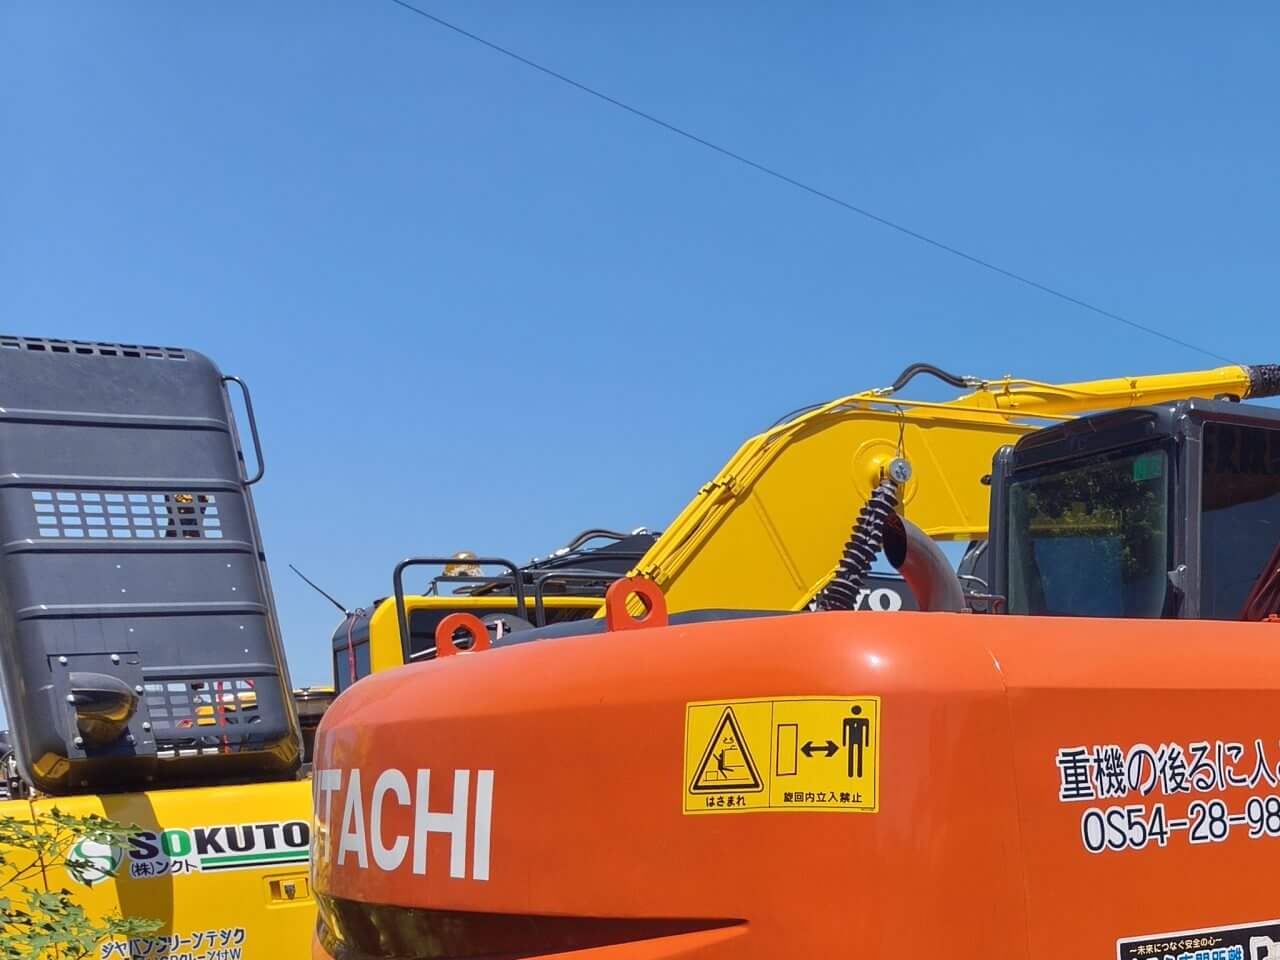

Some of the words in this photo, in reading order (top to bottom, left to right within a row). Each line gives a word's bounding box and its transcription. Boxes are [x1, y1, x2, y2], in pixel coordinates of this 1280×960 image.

[705, 794, 747, 808] はさまれ
[783, 791, 863, 804] 旋回内立入禁止
[128, 821, 311, 861] SOKUTO
